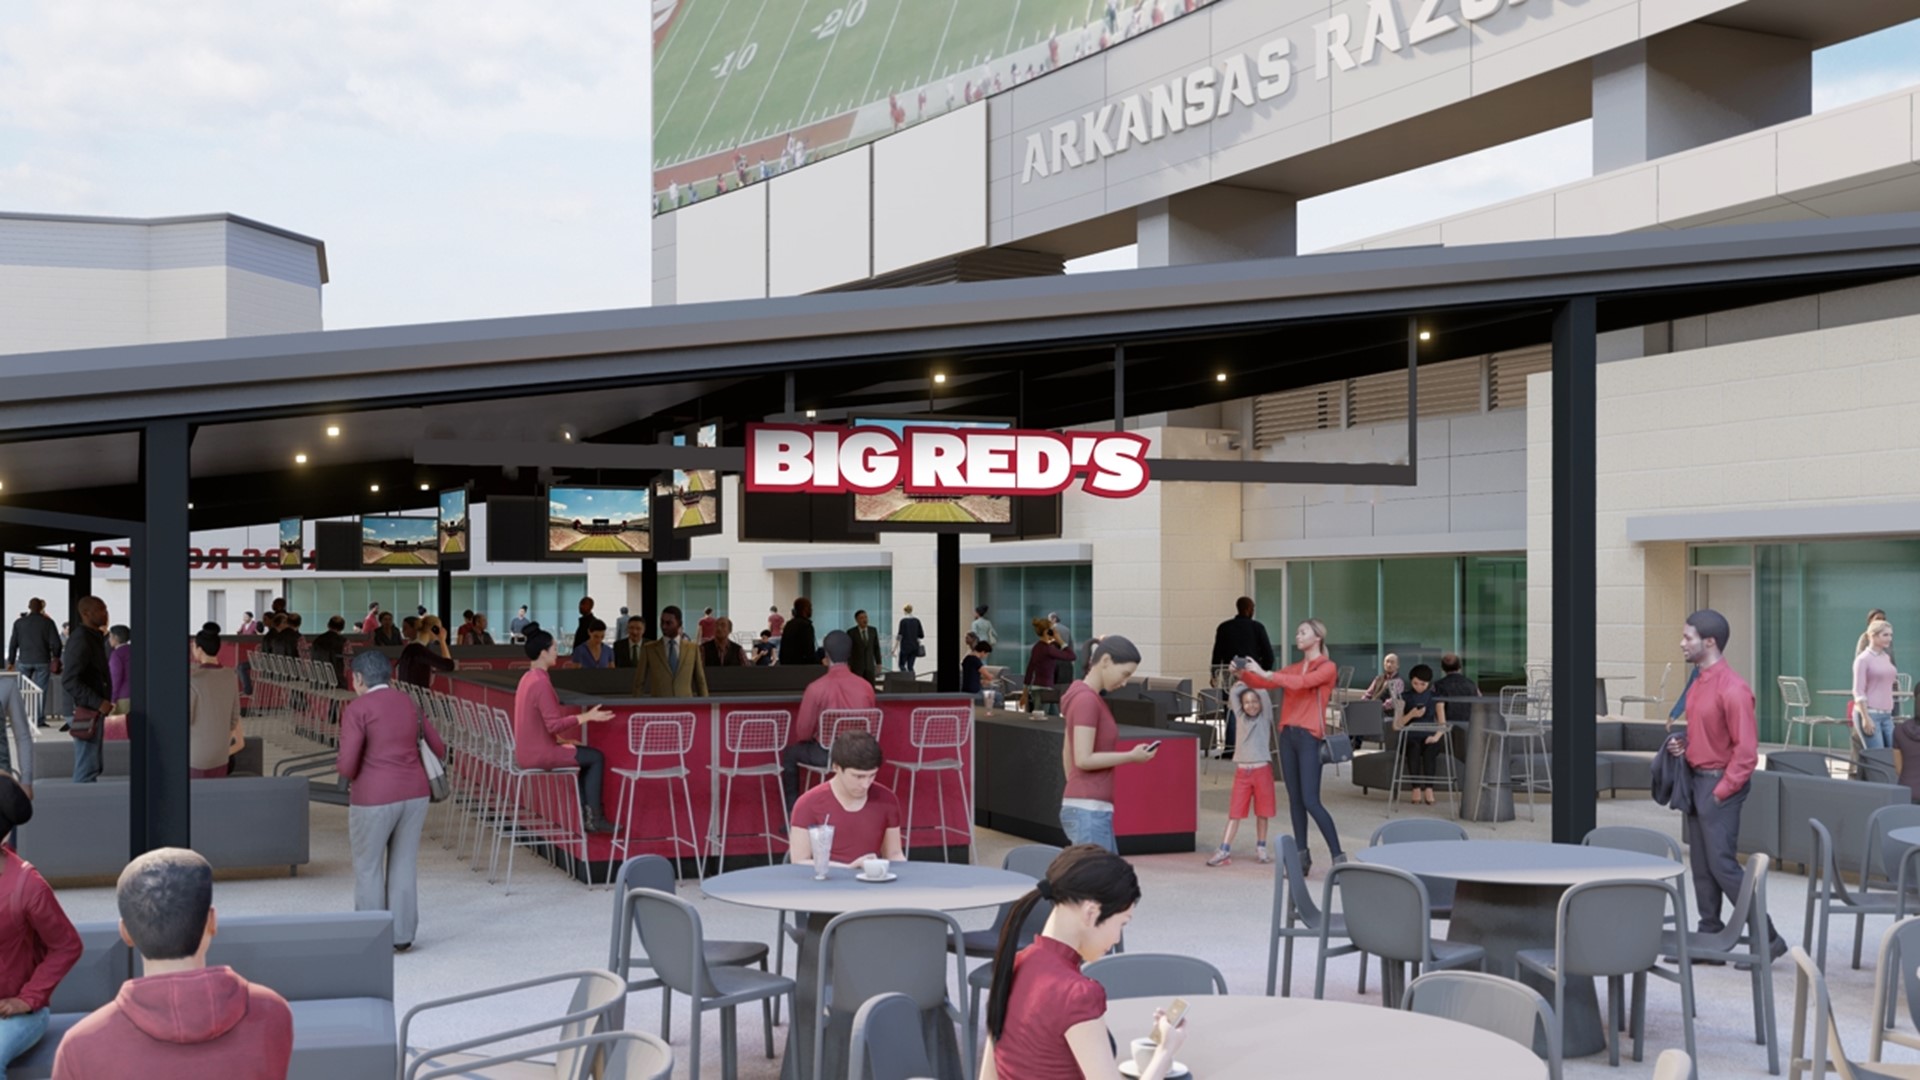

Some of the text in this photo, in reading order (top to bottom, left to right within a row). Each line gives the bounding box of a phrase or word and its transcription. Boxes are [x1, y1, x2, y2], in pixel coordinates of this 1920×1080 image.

[1021, 36, 1292, 184] ARKANSAS
[754, 428, 1147, 492] BIG RED'S
